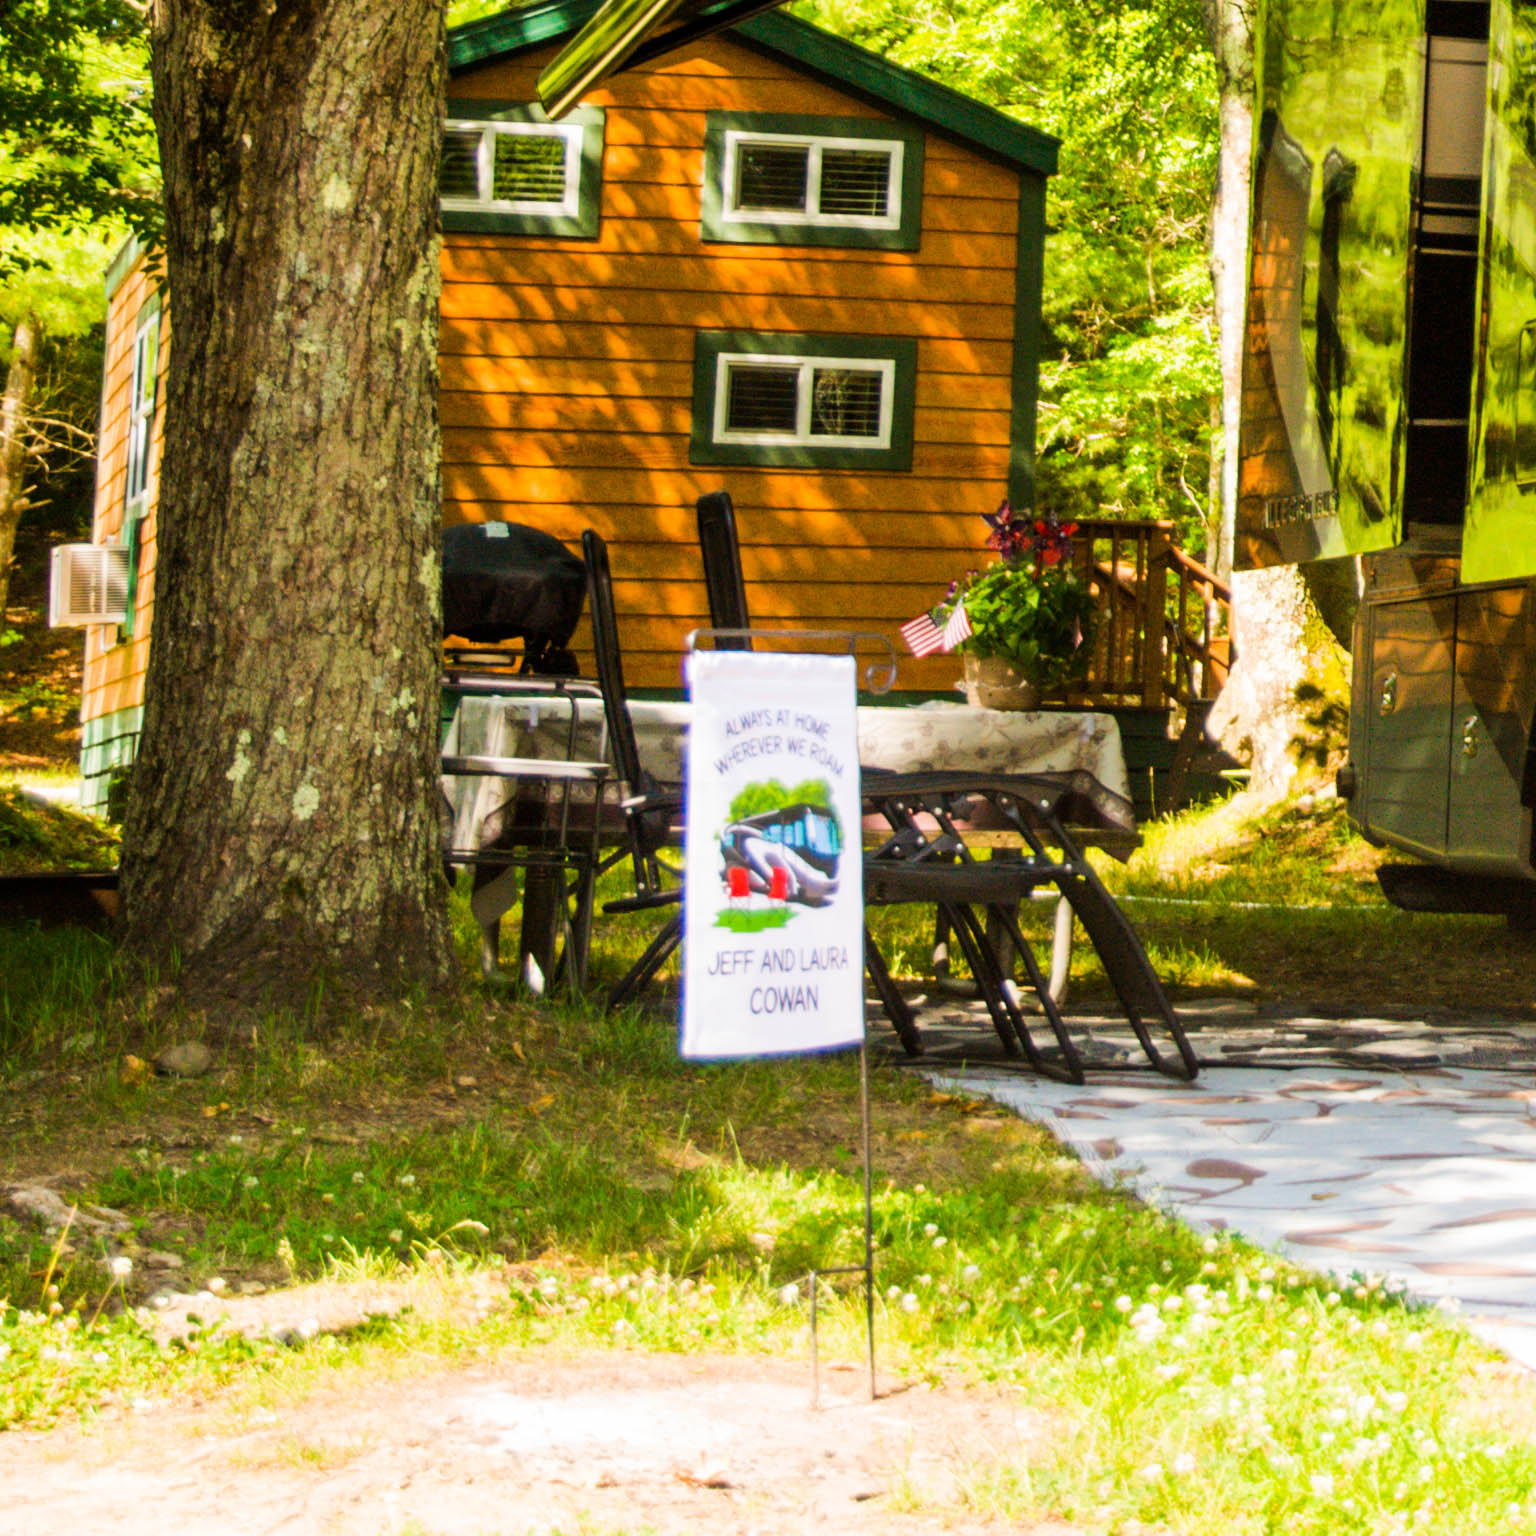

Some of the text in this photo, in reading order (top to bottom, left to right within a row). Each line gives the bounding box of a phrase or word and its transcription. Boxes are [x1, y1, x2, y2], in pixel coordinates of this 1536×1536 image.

[725, 708, 831, 741] ALWAYS AT HOME
[713, 734, 845, 777] WHEREVER WE ROAM
[707, 945, 849, 976] JEFF AND LAURA
[750, 984, 819, 1015] COWAN
